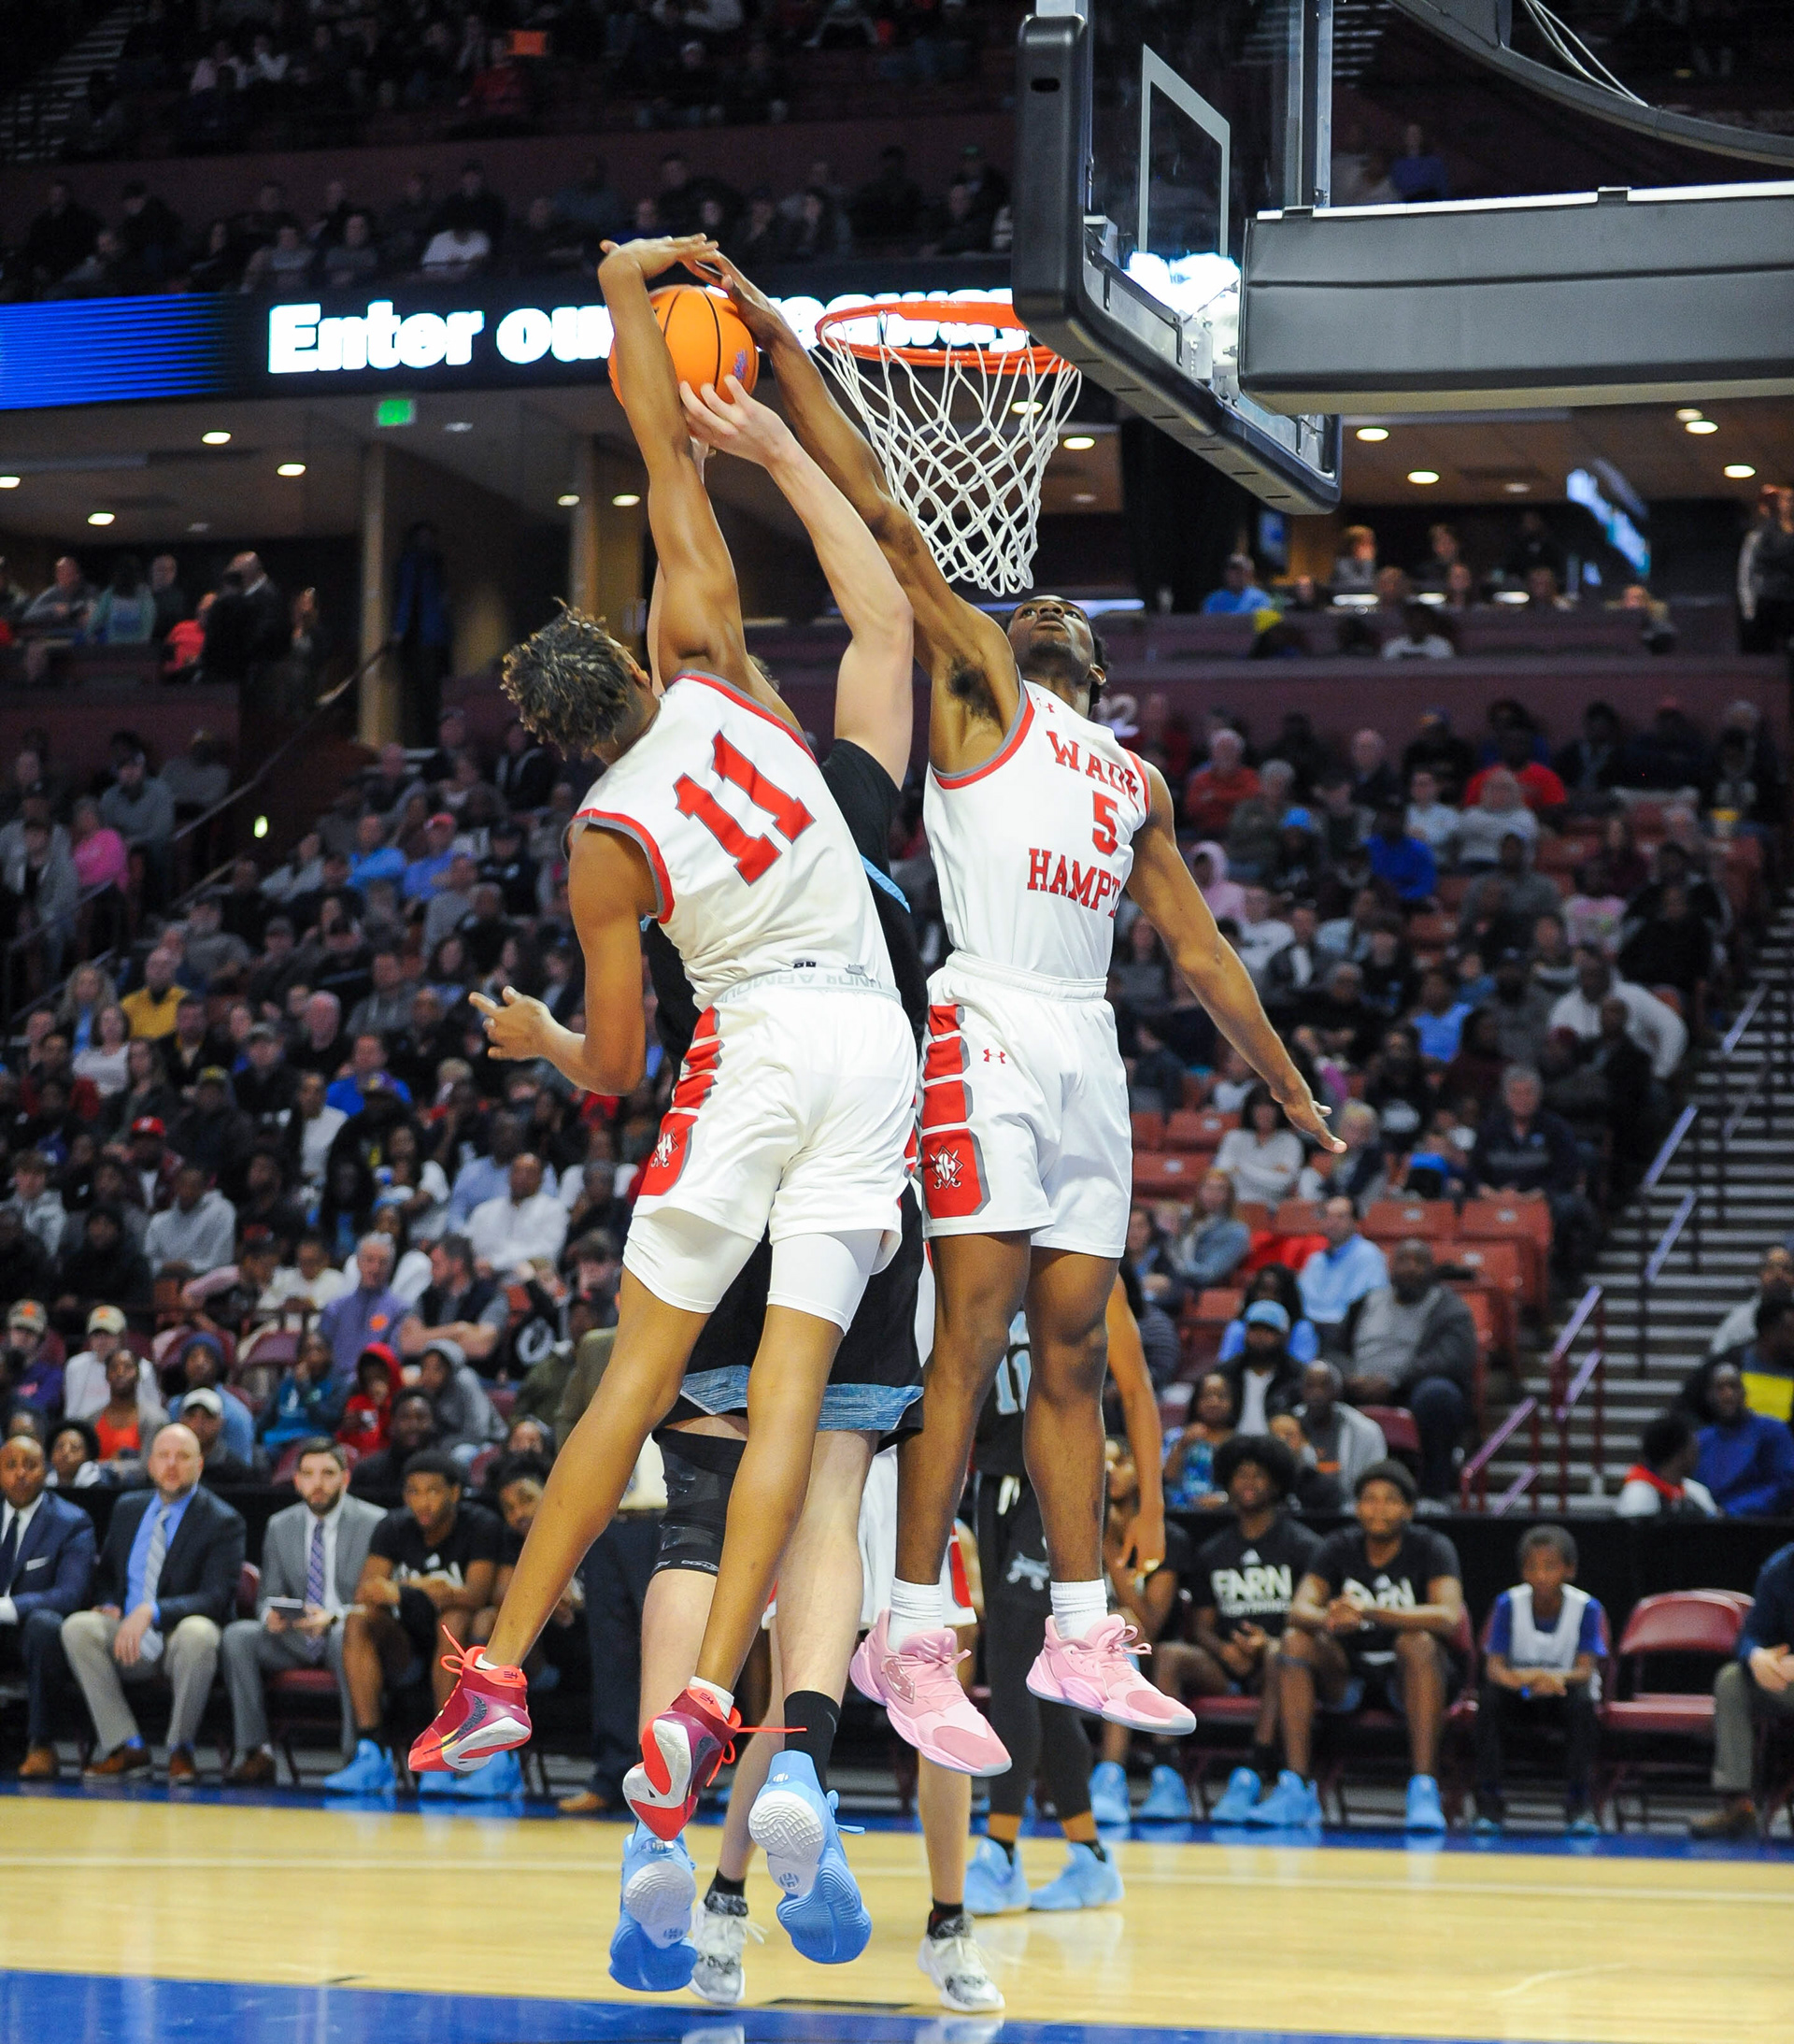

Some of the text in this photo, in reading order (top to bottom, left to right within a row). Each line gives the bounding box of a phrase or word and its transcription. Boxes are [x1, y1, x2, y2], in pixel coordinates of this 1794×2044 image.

[268, 299, 484, 373] Enter
[672, 729, 817, 887] 11
[1046, 730, 1139, 811] WADE
[1091, 790, 1118, 857] 5
